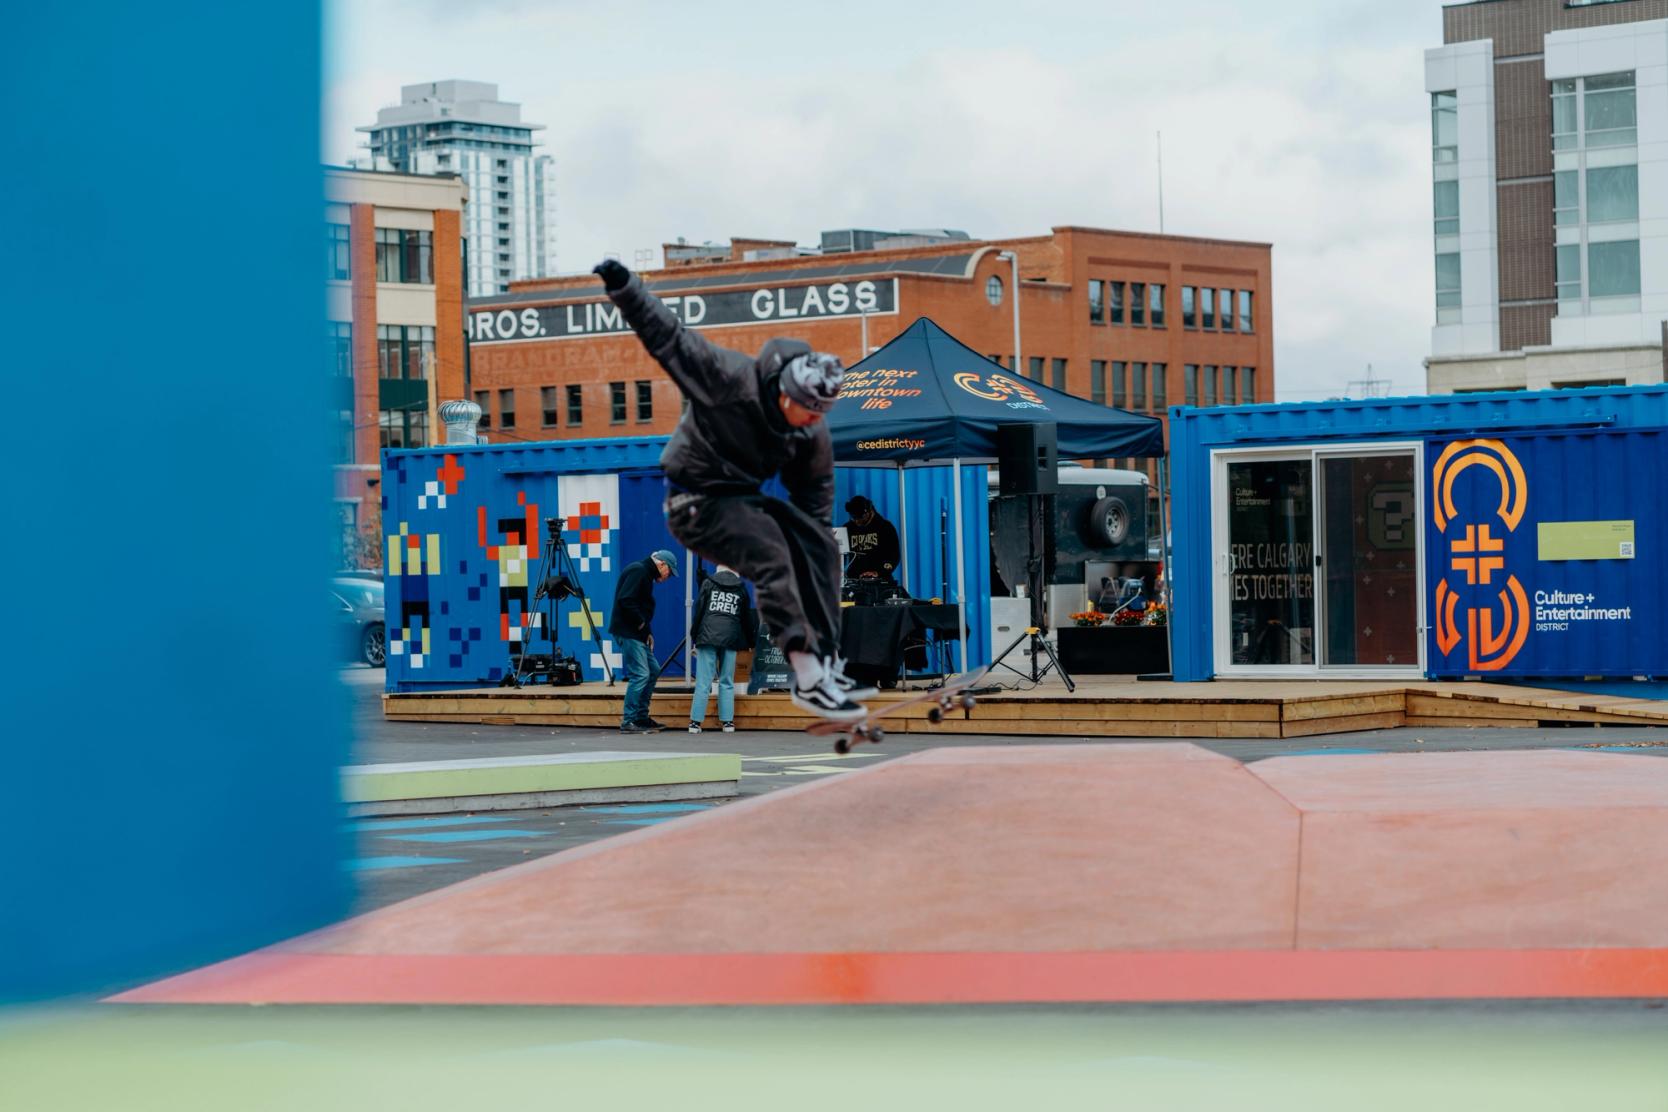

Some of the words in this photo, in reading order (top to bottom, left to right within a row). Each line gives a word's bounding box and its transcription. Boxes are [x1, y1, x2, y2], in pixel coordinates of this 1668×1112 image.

[567, 295, 707, 333] LIMED
[751, 280, 878, 319] GLASS
[872, 368, 918, 379] next
[878, 376, 898, 387] in
[861, 398, 893, 410] life
[856, 438, 926, 452] @cedistrictyyc
[1231, 543, 1254, 569] ERE
[1257, 542, 1311, 569] CALGARY
[1252, 573, 1313, 600] TOGETHER
[711, 590, 741, 605] EAST
[709, 601, 739, 616] CREW
[1535, 605, 1631, 620] Entertainment
[1536, 622, 1569, 632] DISTRICT
